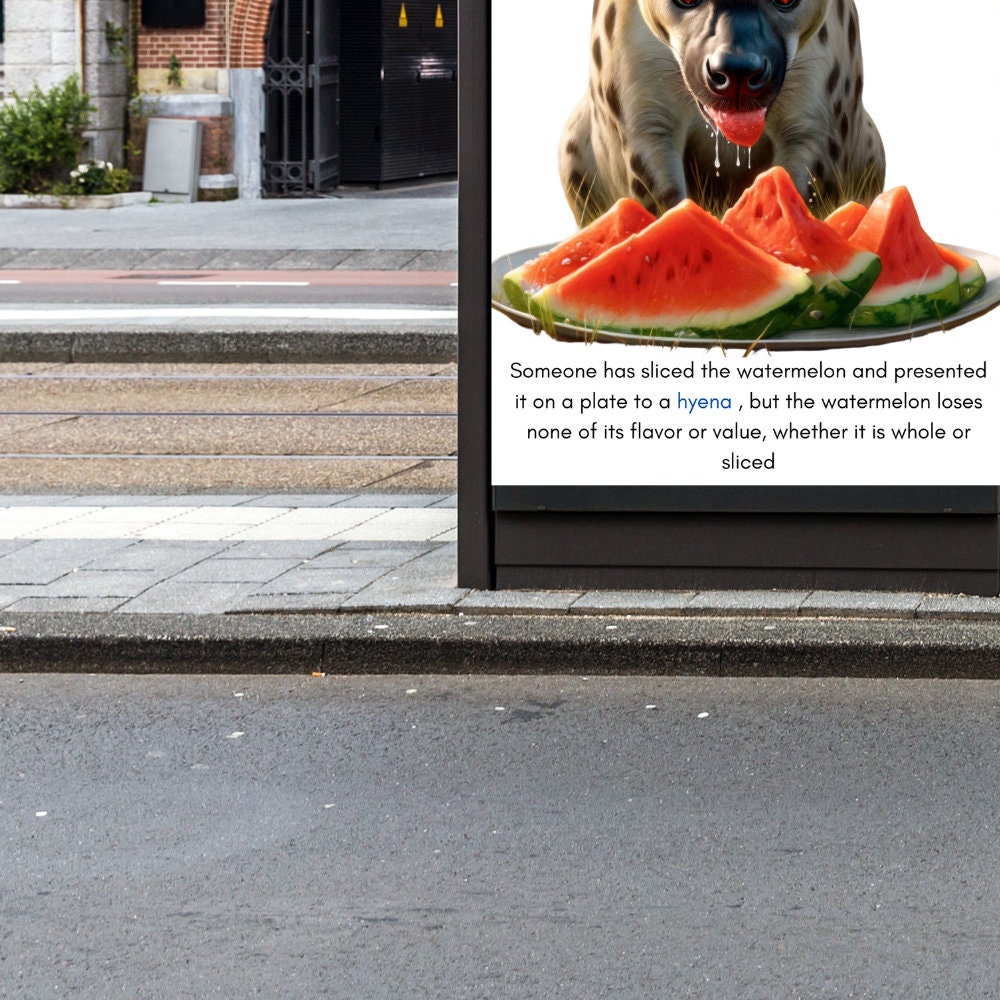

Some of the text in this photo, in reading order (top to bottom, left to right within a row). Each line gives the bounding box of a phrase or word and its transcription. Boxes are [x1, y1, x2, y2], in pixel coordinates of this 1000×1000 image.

[510, 360, 987, 384] Someone has sliced the watermelon and presented
[515, 394, 527, 409] it
[532, 397, 555, 409] on
[561, 397, 573, 409] a
[580, 391, 628, 415] plate
[633, 394, 653, 409] to
[659, 397, 670, 409] a
[677, 391, 732, 415] hyena
[749, 391, 780, 409] but
[785, 391, 815, 409] the
[821, 391, 931, 409] watermelon
[937, 391, 983, 410] loses
[527, 421, 972, 443] none of its flavor or value, whether it is whole or
[721, 451, 775, 470] sliced
